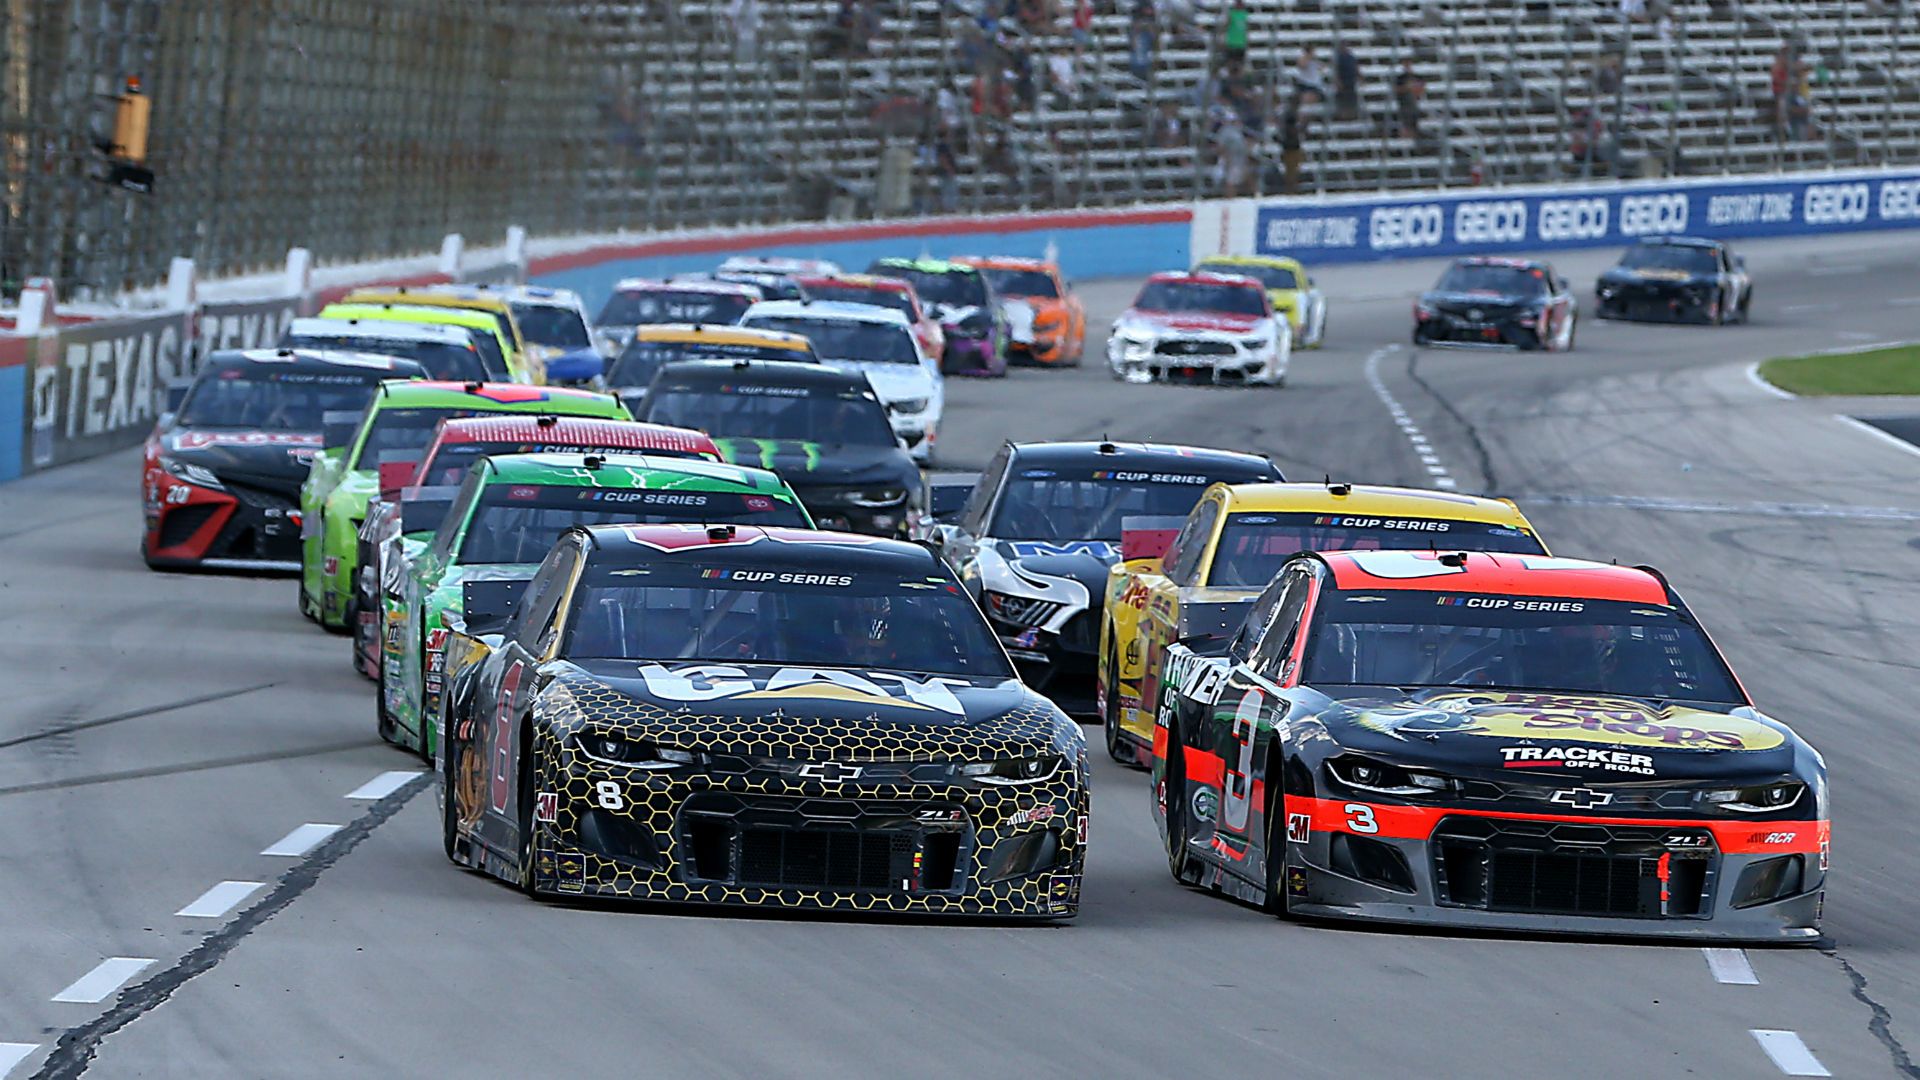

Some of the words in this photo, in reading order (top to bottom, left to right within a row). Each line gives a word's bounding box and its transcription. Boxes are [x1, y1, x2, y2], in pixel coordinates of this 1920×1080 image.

[1803, 183, 1869, 224] GEICO
[1879, 181, 1920, 220] GEI
[1370, 205, 1443, 249] GEICO
[1454, 201, 1527, 243] GEICO
[1538, 198, 1609, 240] GEICO
[1620, 194, 1688, 236] GEICO
[65, 325, 178, 439] TEXAS
[738, 386, 764, 394] CUP
[1116, 472, 1149, 481] CUP
[1150, 473, 1207, 484] SERIES
[166, 485, 192, 503] 20
[604, 492, 641, 502] CUP
[643, 494, 707, 506] SERIES
[1342, 517, 1381, 528] CUP
[1383, 519, 1450, 532] SERIES
[732, 571, 776, 582] CUP
[778, 573, 853, 586] SERIES
[1466, 598, 1509, 610] CUP
[1511, 600, 1584, 613] SERIES
[1500, 747, 1653, 767] TRACKER
[1565, 760, 1600, 769] OFF
[1604, 763, 1656, 775] ROAD
[537, 794, 557, 821] 3M
[596, 781, 624, 809] 8
[1289, 814, 1309, 842] 3M
[1345, 803, 1379, 834] 3
[1764, 832, 1796, 844] RCR
